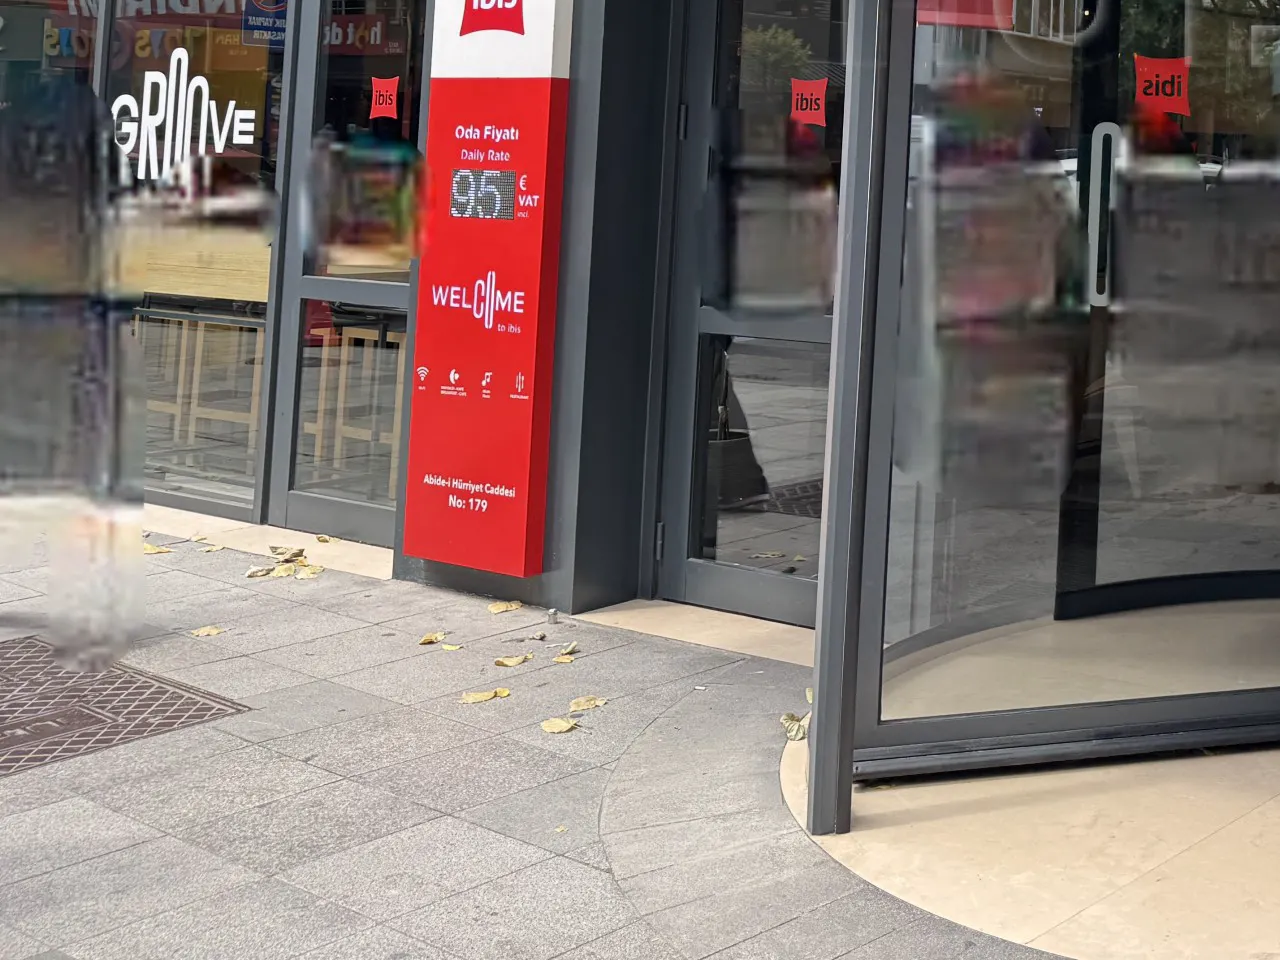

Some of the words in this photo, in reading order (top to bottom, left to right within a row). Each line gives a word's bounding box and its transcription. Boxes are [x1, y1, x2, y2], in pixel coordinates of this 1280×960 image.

[374, 87, 394, 110] ibis
[795, 93, 821, 113] ibis
[111, 47, 256, 180] GROOVE
[455, 125, 480, 140] Oda
[483, 125, 519, 142] Fiyatı
[461, 149, 485, 162] Daily
[488, 149, 510, 162] Rate
[519, 174, 528, 190] €
[451, 169, 501, 218] 95
[518, 195, 540, 207] VAT
[432, 271, 525, 329] WELCOME
[497, 324, 506, 332] to
[507, 324, 521, 334] ibis
[423, 473, 451, 488] Abide-i
[451, 476, 484, 494] Hürriyet
[484, 483, 516, 498] Caddesi
[448, 495, 466, 509] No:
[468, 498, 488, 513] 179
